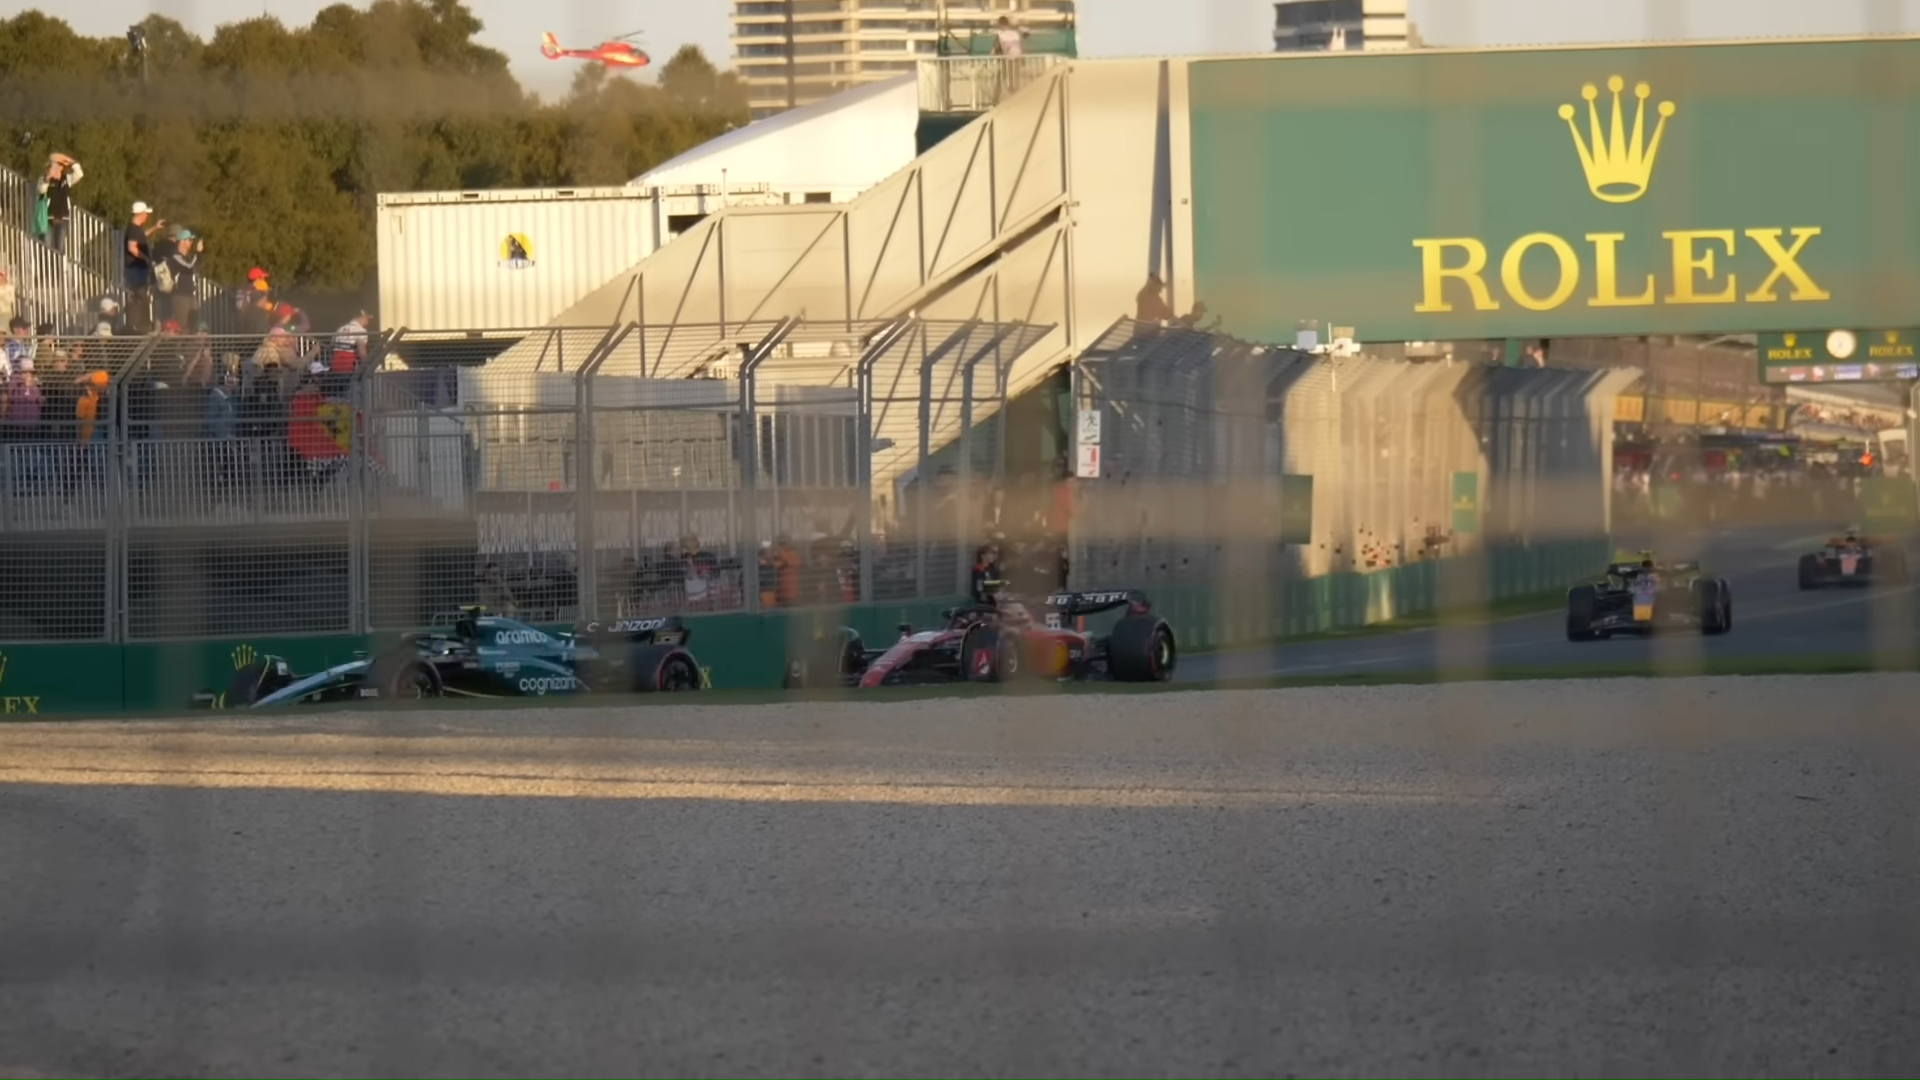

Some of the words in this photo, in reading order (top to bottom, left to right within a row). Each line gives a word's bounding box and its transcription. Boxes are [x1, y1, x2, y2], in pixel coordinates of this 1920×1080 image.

[1412, 226, 1830, 313] ROLEX
[1768, 348, 1812, 360] ROLEX
[495, 629, 549, 645] aramco
[518, 676, 577, 696] cognizant
